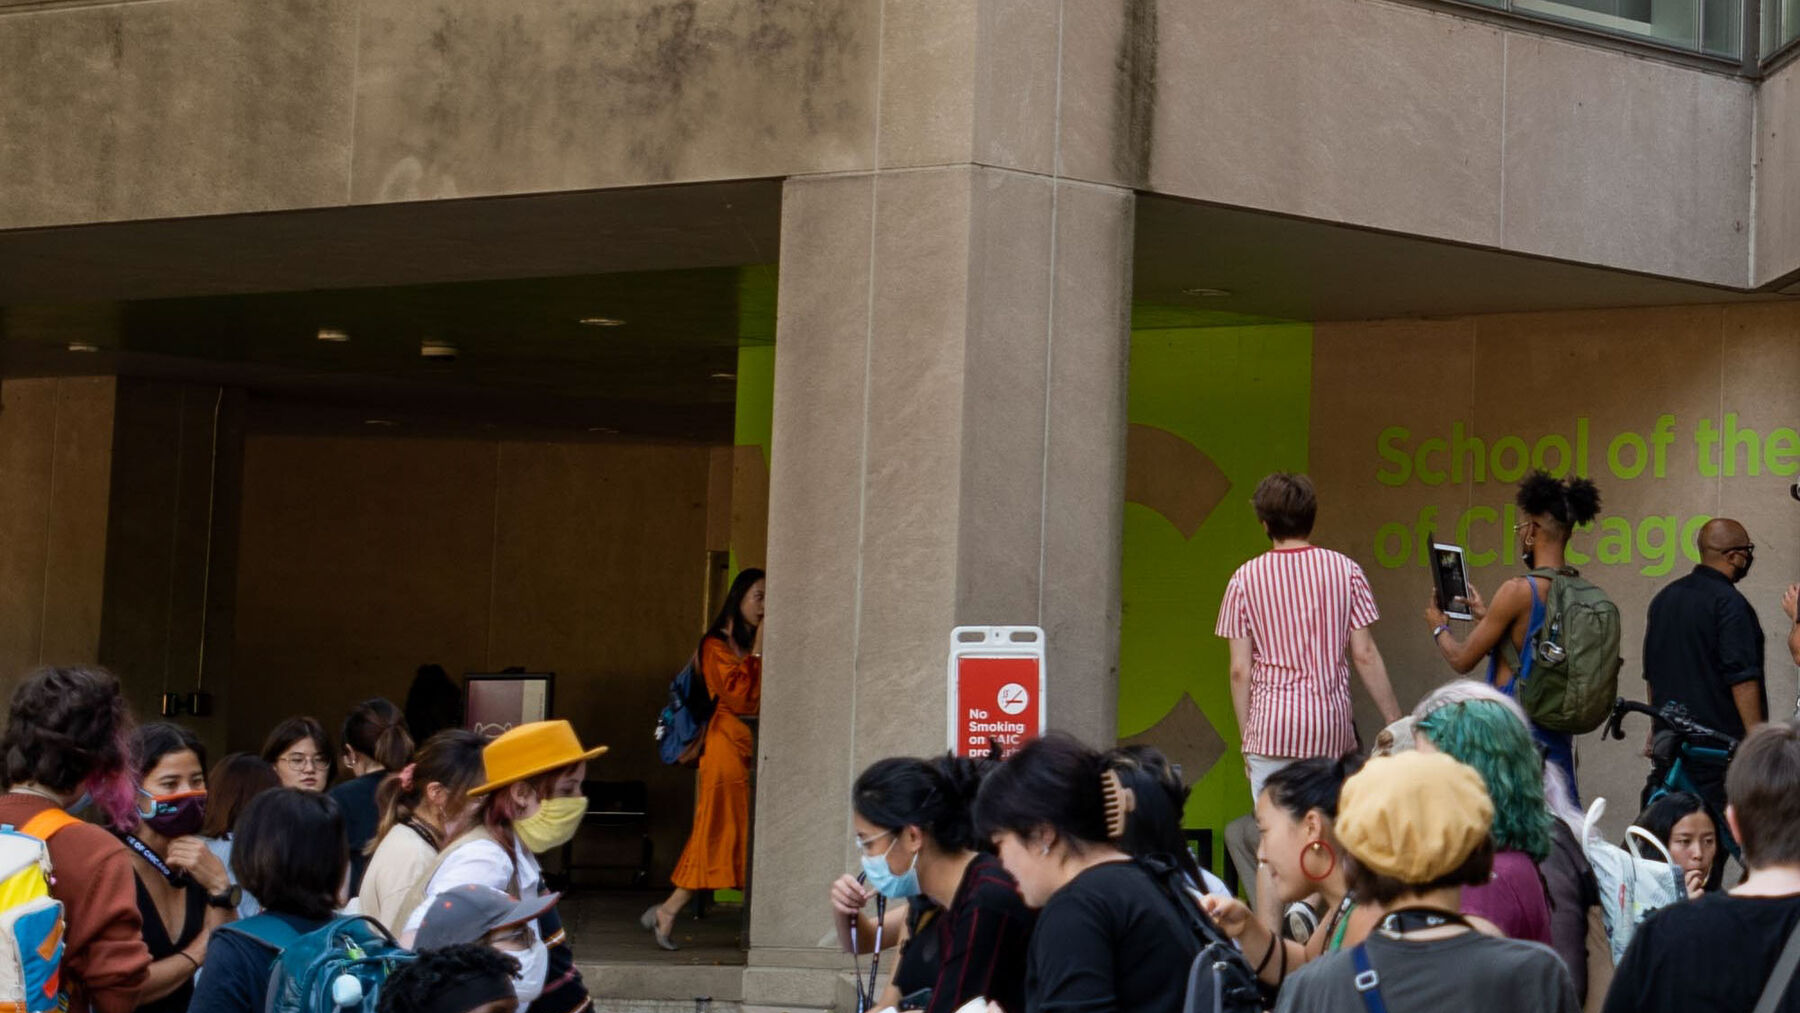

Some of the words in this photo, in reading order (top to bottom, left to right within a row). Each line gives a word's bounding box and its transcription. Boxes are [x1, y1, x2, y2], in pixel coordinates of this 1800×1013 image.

[1376, 417, 1589, 486] School
[1607, 413, 1676, 480] of
[1695, 412, 1800, 477] the
[1374, 504, 1440, 568] of
[1455, 503, 1713, 577] Ccago
[970, 708, 988, 719] No
[969, 721, 1025, 734] Smoking
[969, 735, 986, 745] on
